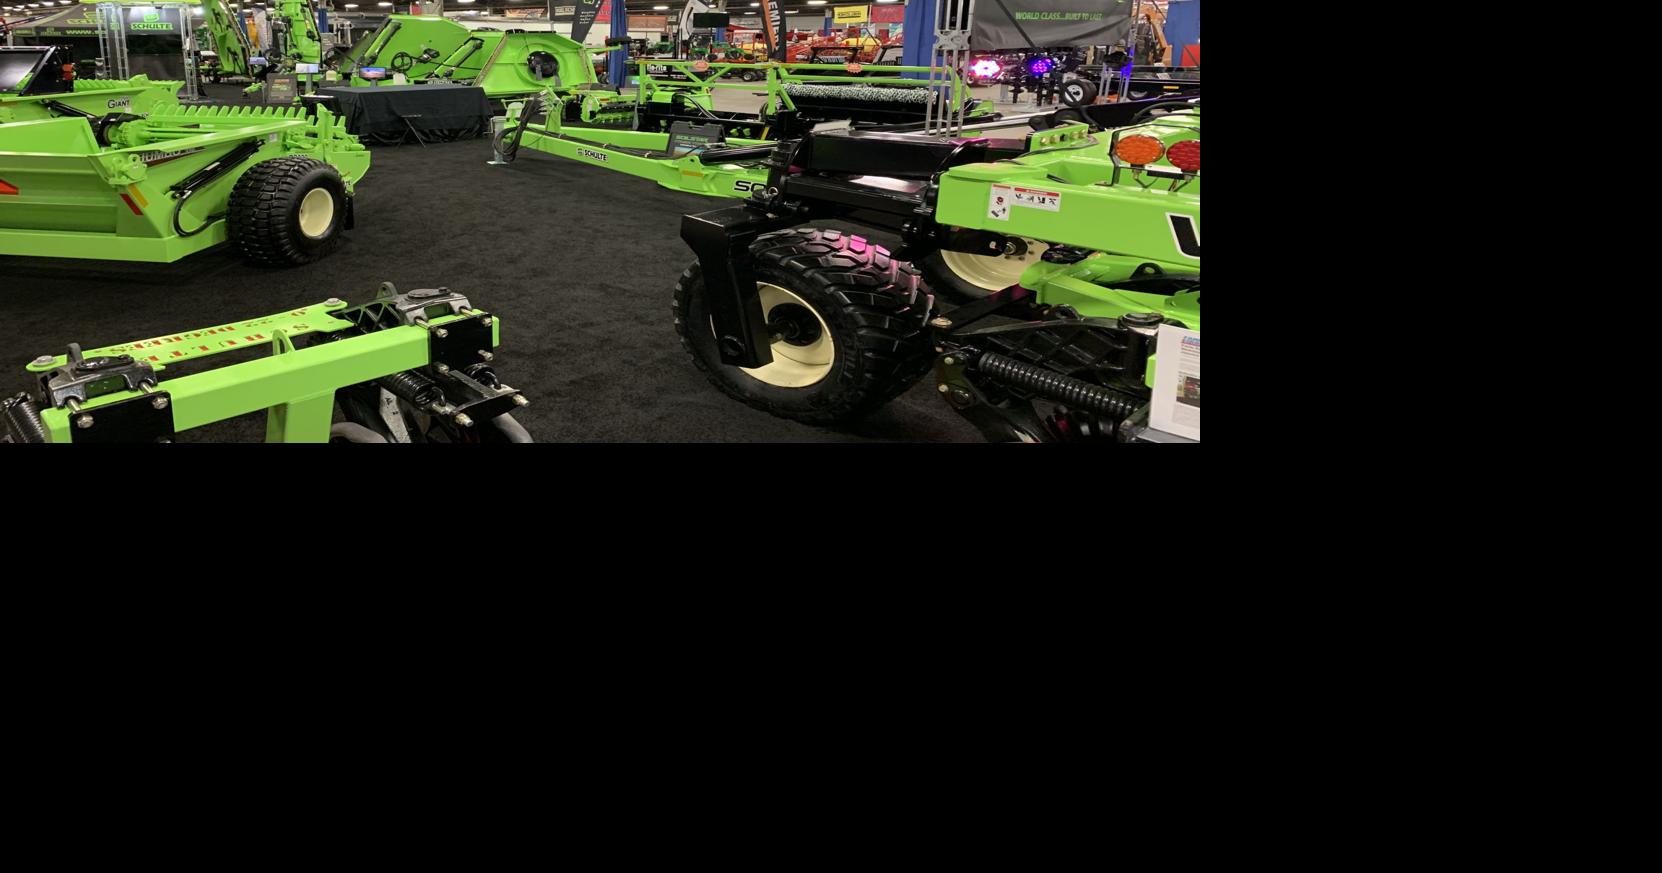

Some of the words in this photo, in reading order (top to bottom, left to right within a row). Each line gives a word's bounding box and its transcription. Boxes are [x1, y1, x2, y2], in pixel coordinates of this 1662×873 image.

[1016, 12, 1039, 20] WORLD
[131, 22, 172, 30] SCHULTE
[107, 99, 129, 109] GIANT
[584, 149, 608, 161] SCHULTE
